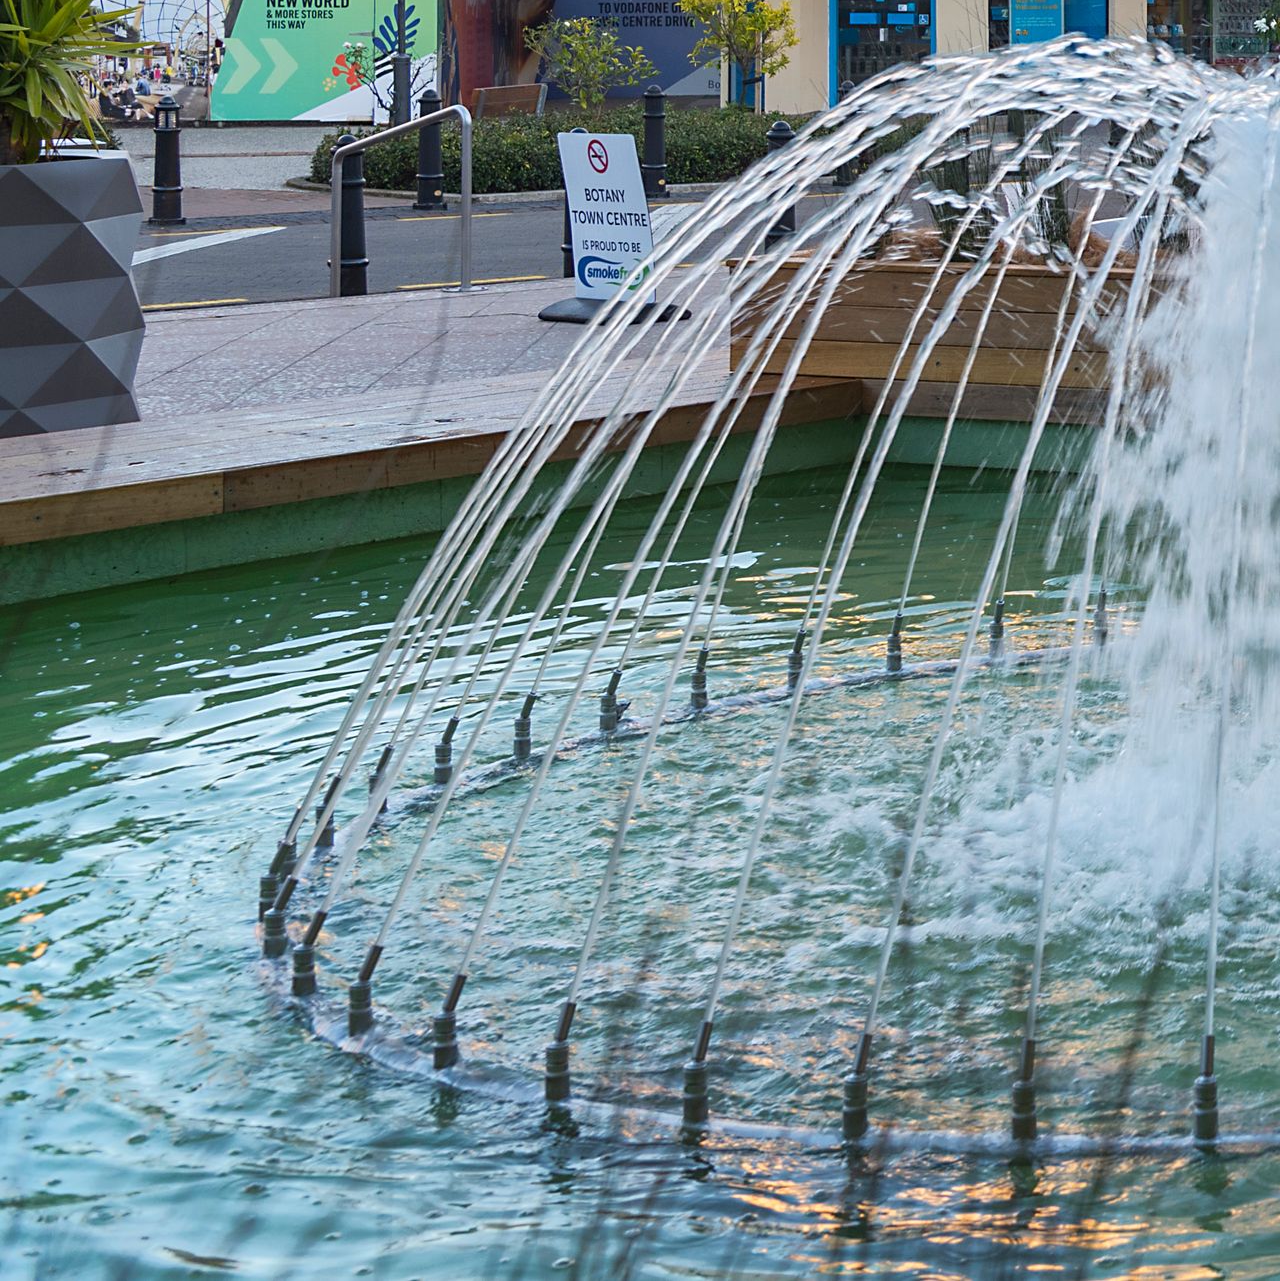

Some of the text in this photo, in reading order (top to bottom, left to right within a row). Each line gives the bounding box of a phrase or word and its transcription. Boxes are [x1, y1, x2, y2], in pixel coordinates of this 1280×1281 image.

[266, 9, 333, 19] & MORE STORES
[598, 2, 611, 14] TO
[614, 2, 669, 14] VODAFONE
[267, 20, 306, 29] THIS WAY
[622, 15, 663, 27] CENTRE
[585, 188, 625, 203] BOTANY
[572, 210, 648, 227] TOWN CENTRE
[582, 239, 642, 253] IS PROUD TO BE
